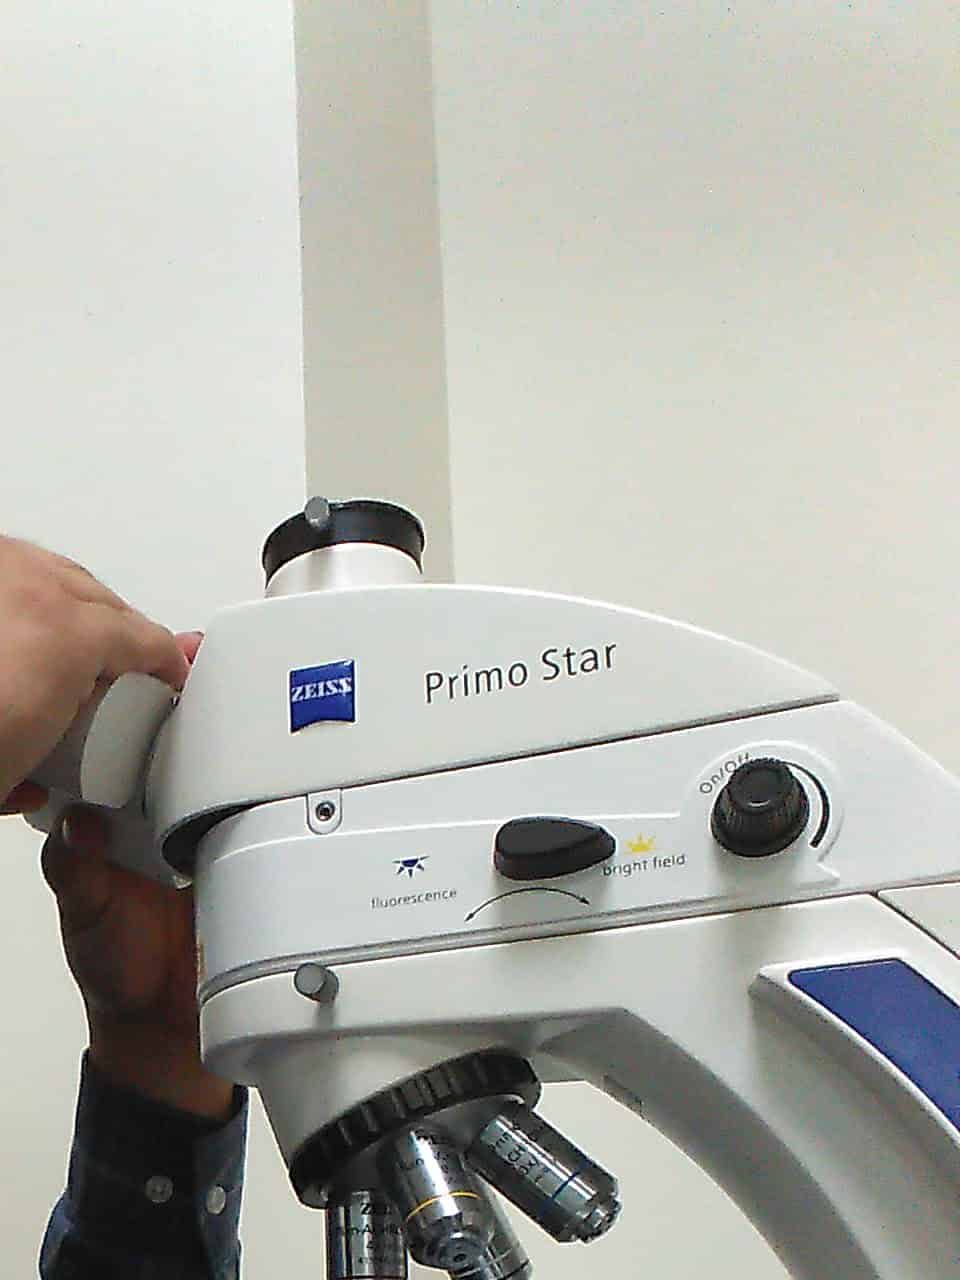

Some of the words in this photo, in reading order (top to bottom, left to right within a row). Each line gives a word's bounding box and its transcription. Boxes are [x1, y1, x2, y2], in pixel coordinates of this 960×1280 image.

[424, 660, 529, 703] Primo
[541, 642, 617, 680] Star
[290, 677, 353, 702] ZEISS
[602, 859, 648, 878] bright
[652, 854, 686, 869] field
[370, 889, 457, 909] fluorescence
